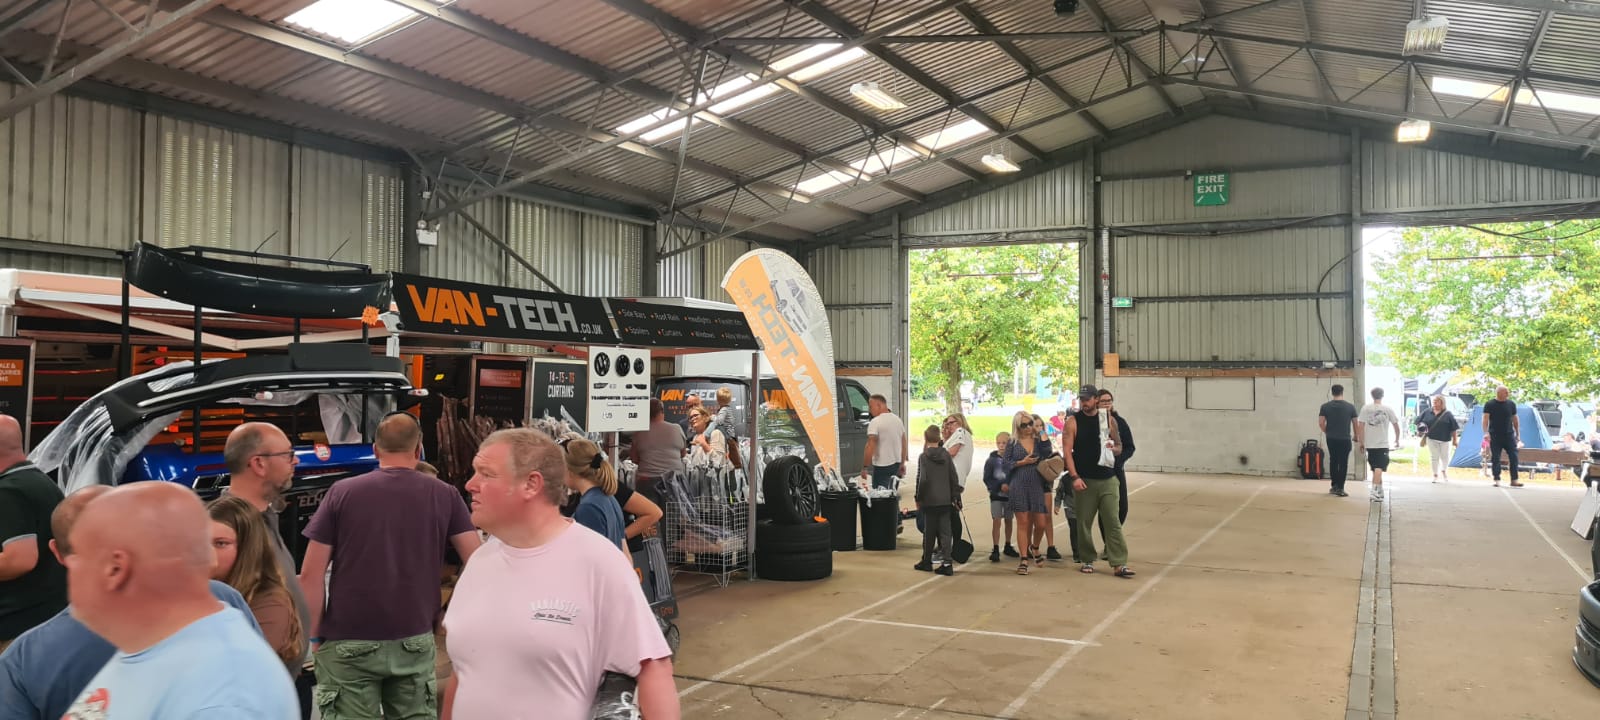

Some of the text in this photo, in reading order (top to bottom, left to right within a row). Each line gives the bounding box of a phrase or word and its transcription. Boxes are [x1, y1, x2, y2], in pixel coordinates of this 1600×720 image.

[1197, 174, 1225, 184] FIRE
[1197, 184, 1225, 194] EXIT
[548, 384, 575, 399] CURTAINS
